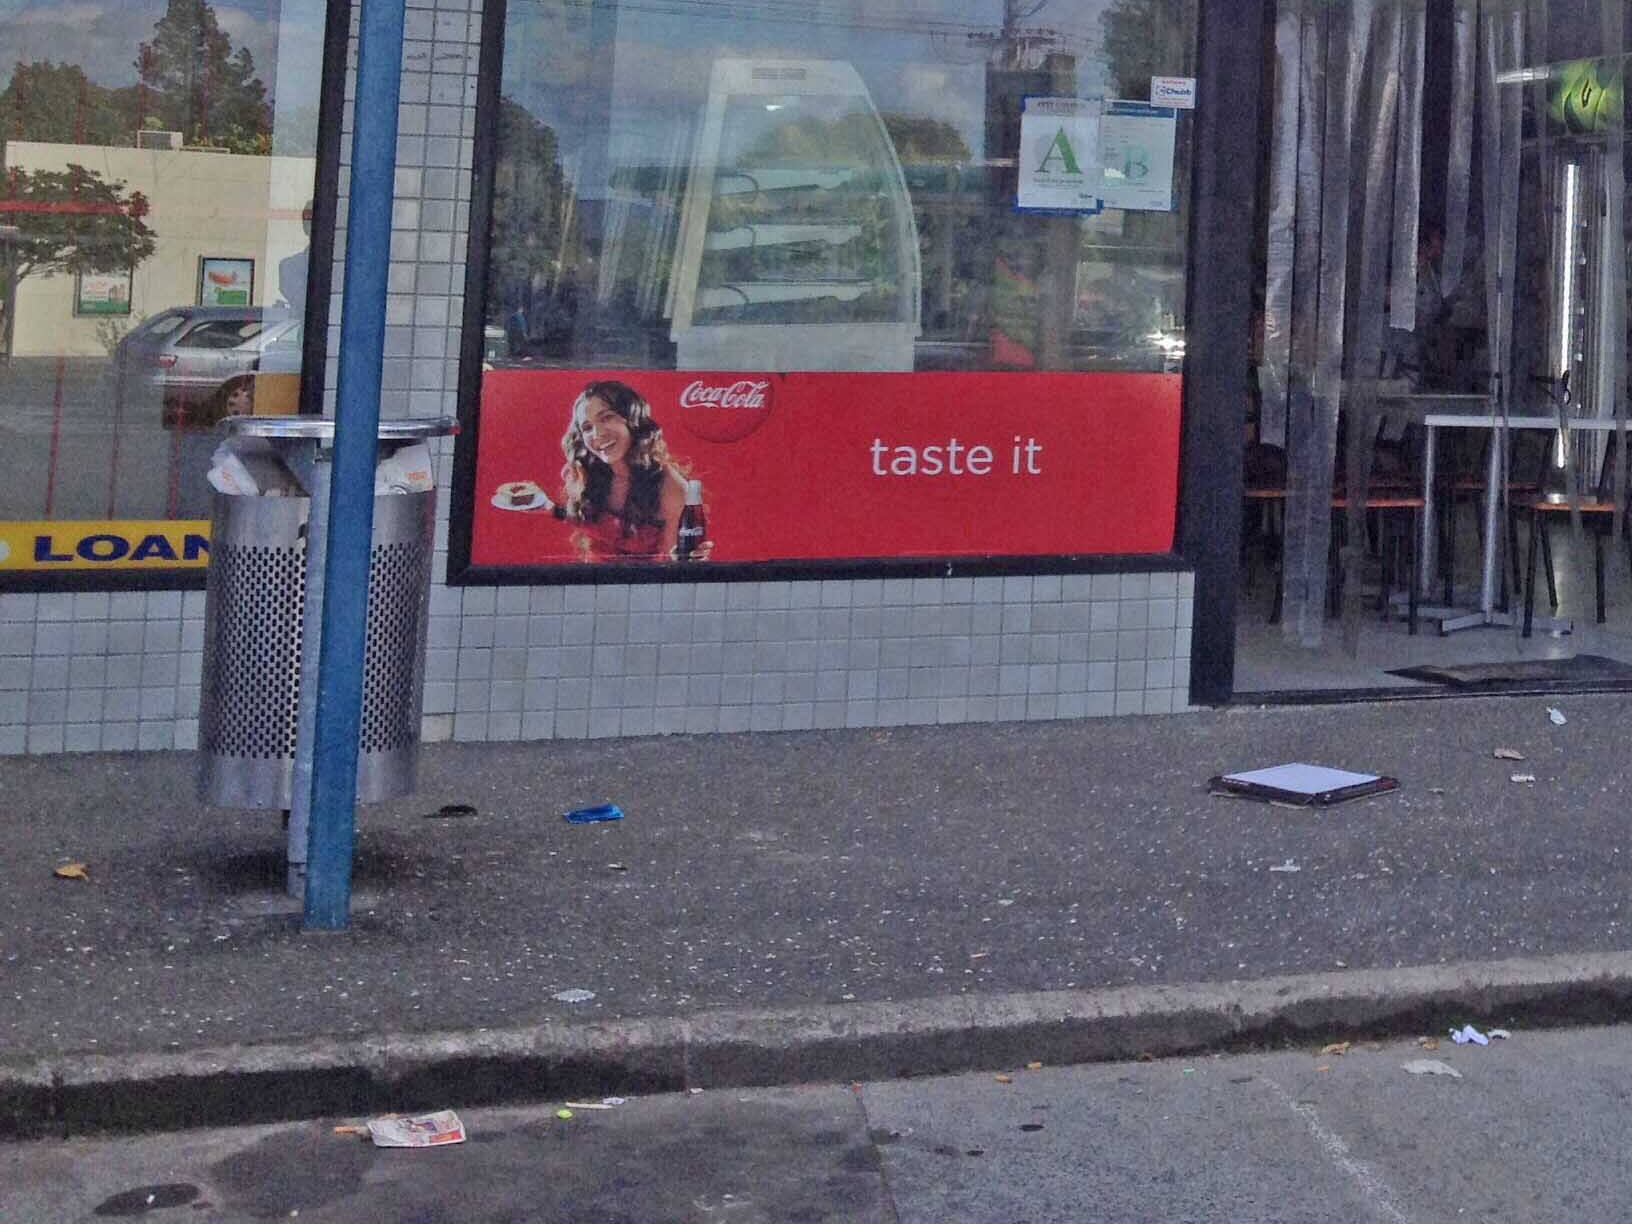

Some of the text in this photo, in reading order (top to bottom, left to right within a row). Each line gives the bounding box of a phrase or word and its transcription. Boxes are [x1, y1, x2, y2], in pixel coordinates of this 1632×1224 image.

[1032, 126, 1084, 175] A
[869, 435, 1044, 475] taste it
